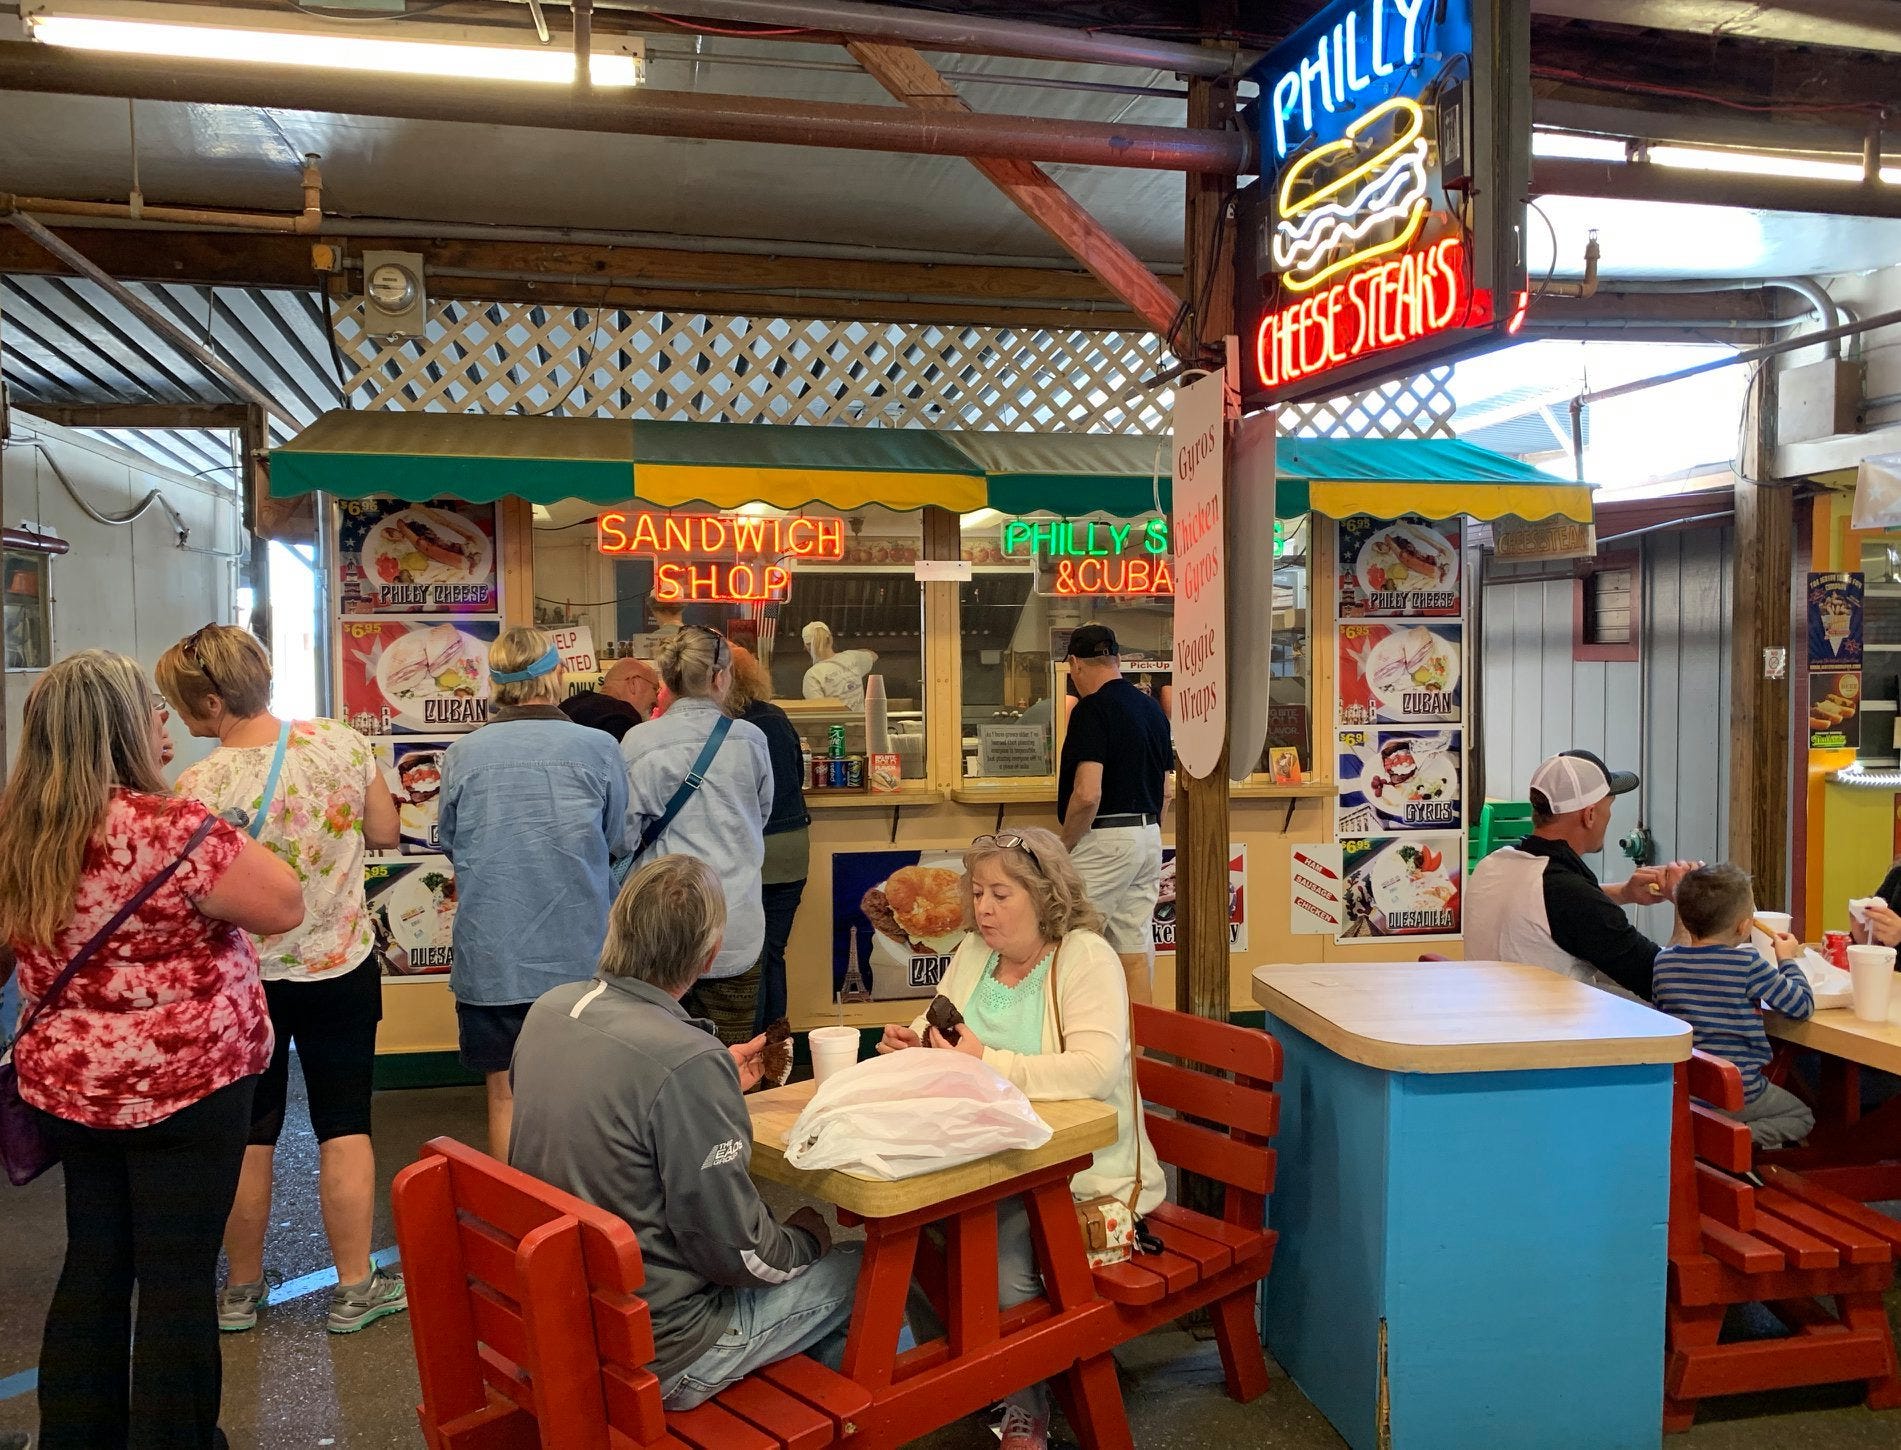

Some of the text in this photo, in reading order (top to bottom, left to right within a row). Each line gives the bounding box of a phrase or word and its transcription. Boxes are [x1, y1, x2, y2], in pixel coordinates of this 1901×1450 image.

[1273, 0, 1428, 158] PHILLY
[1179, 425, 1215, 481] Gyros
[600, 513, 841, 555] SANDWICH
[1005, 521, 1131, 555] PHILLY
[1175, 494, 1219, 558] Chicken
[657, 563, 789, 600] SHOP
[1055, 558, 1174, 595] &CUBA
[1185, 547, 1218, 602] Gyros
[380, 584, 489, 605] PHILLY CHEESE
[1369, 591, 1455, 610] PHILLY CHEESE
[1178, 623, 1215, 676] Veggie
[563, 654, 592, 672] NTED
[1130, 662, 1170, 670] Pick-Up
[424, 698, 489, 724] CUBAN
[1179, 681, 1217, 724] Wraps
[1402, 692, 1452, 715] CUBAN
[1268, 727, 1300, 735] LAVOR.
[1405, 801, 1452, 823] GYROS
[1304, 858, 1323, 872] HAM
[1296, 875, 1333, 900] SAUSAGE
[1297, 899, 1332, 921] CHICKEN
[1388, 910, 1454, 929] QUESADILLA
[410, 946, 453, 967] QUESA
